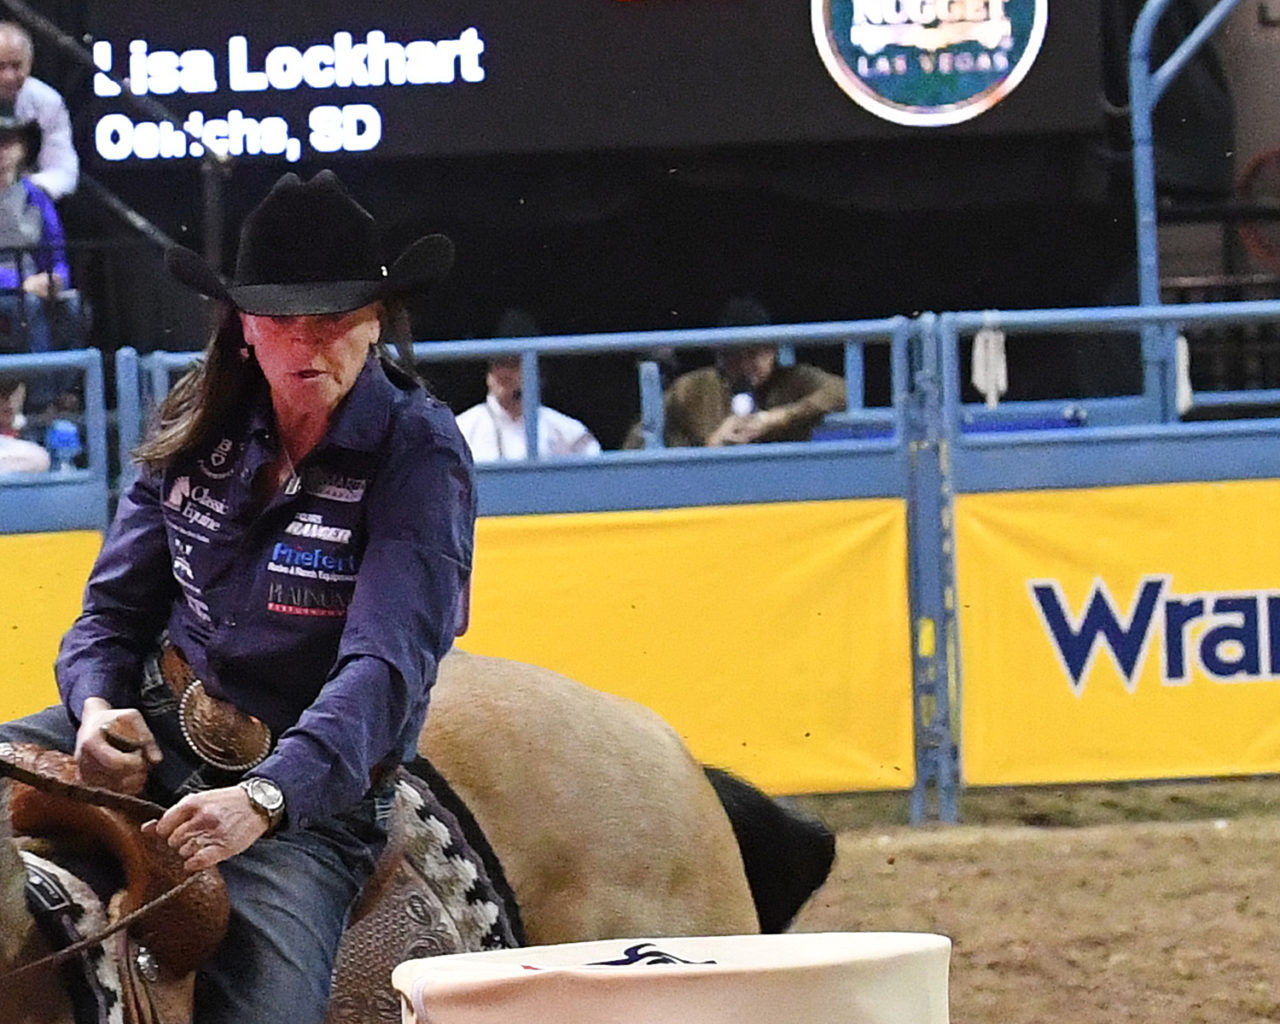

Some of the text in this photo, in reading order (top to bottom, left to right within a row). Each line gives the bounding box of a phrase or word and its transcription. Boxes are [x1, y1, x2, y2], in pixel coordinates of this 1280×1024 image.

[93, 26, 485, 97] Lisa Lockhart
[857, 50, 1010, 78] LAS VEGAS
[308, 104, 382, 152] SD
[1028, 576, 1280, 692] Wra
